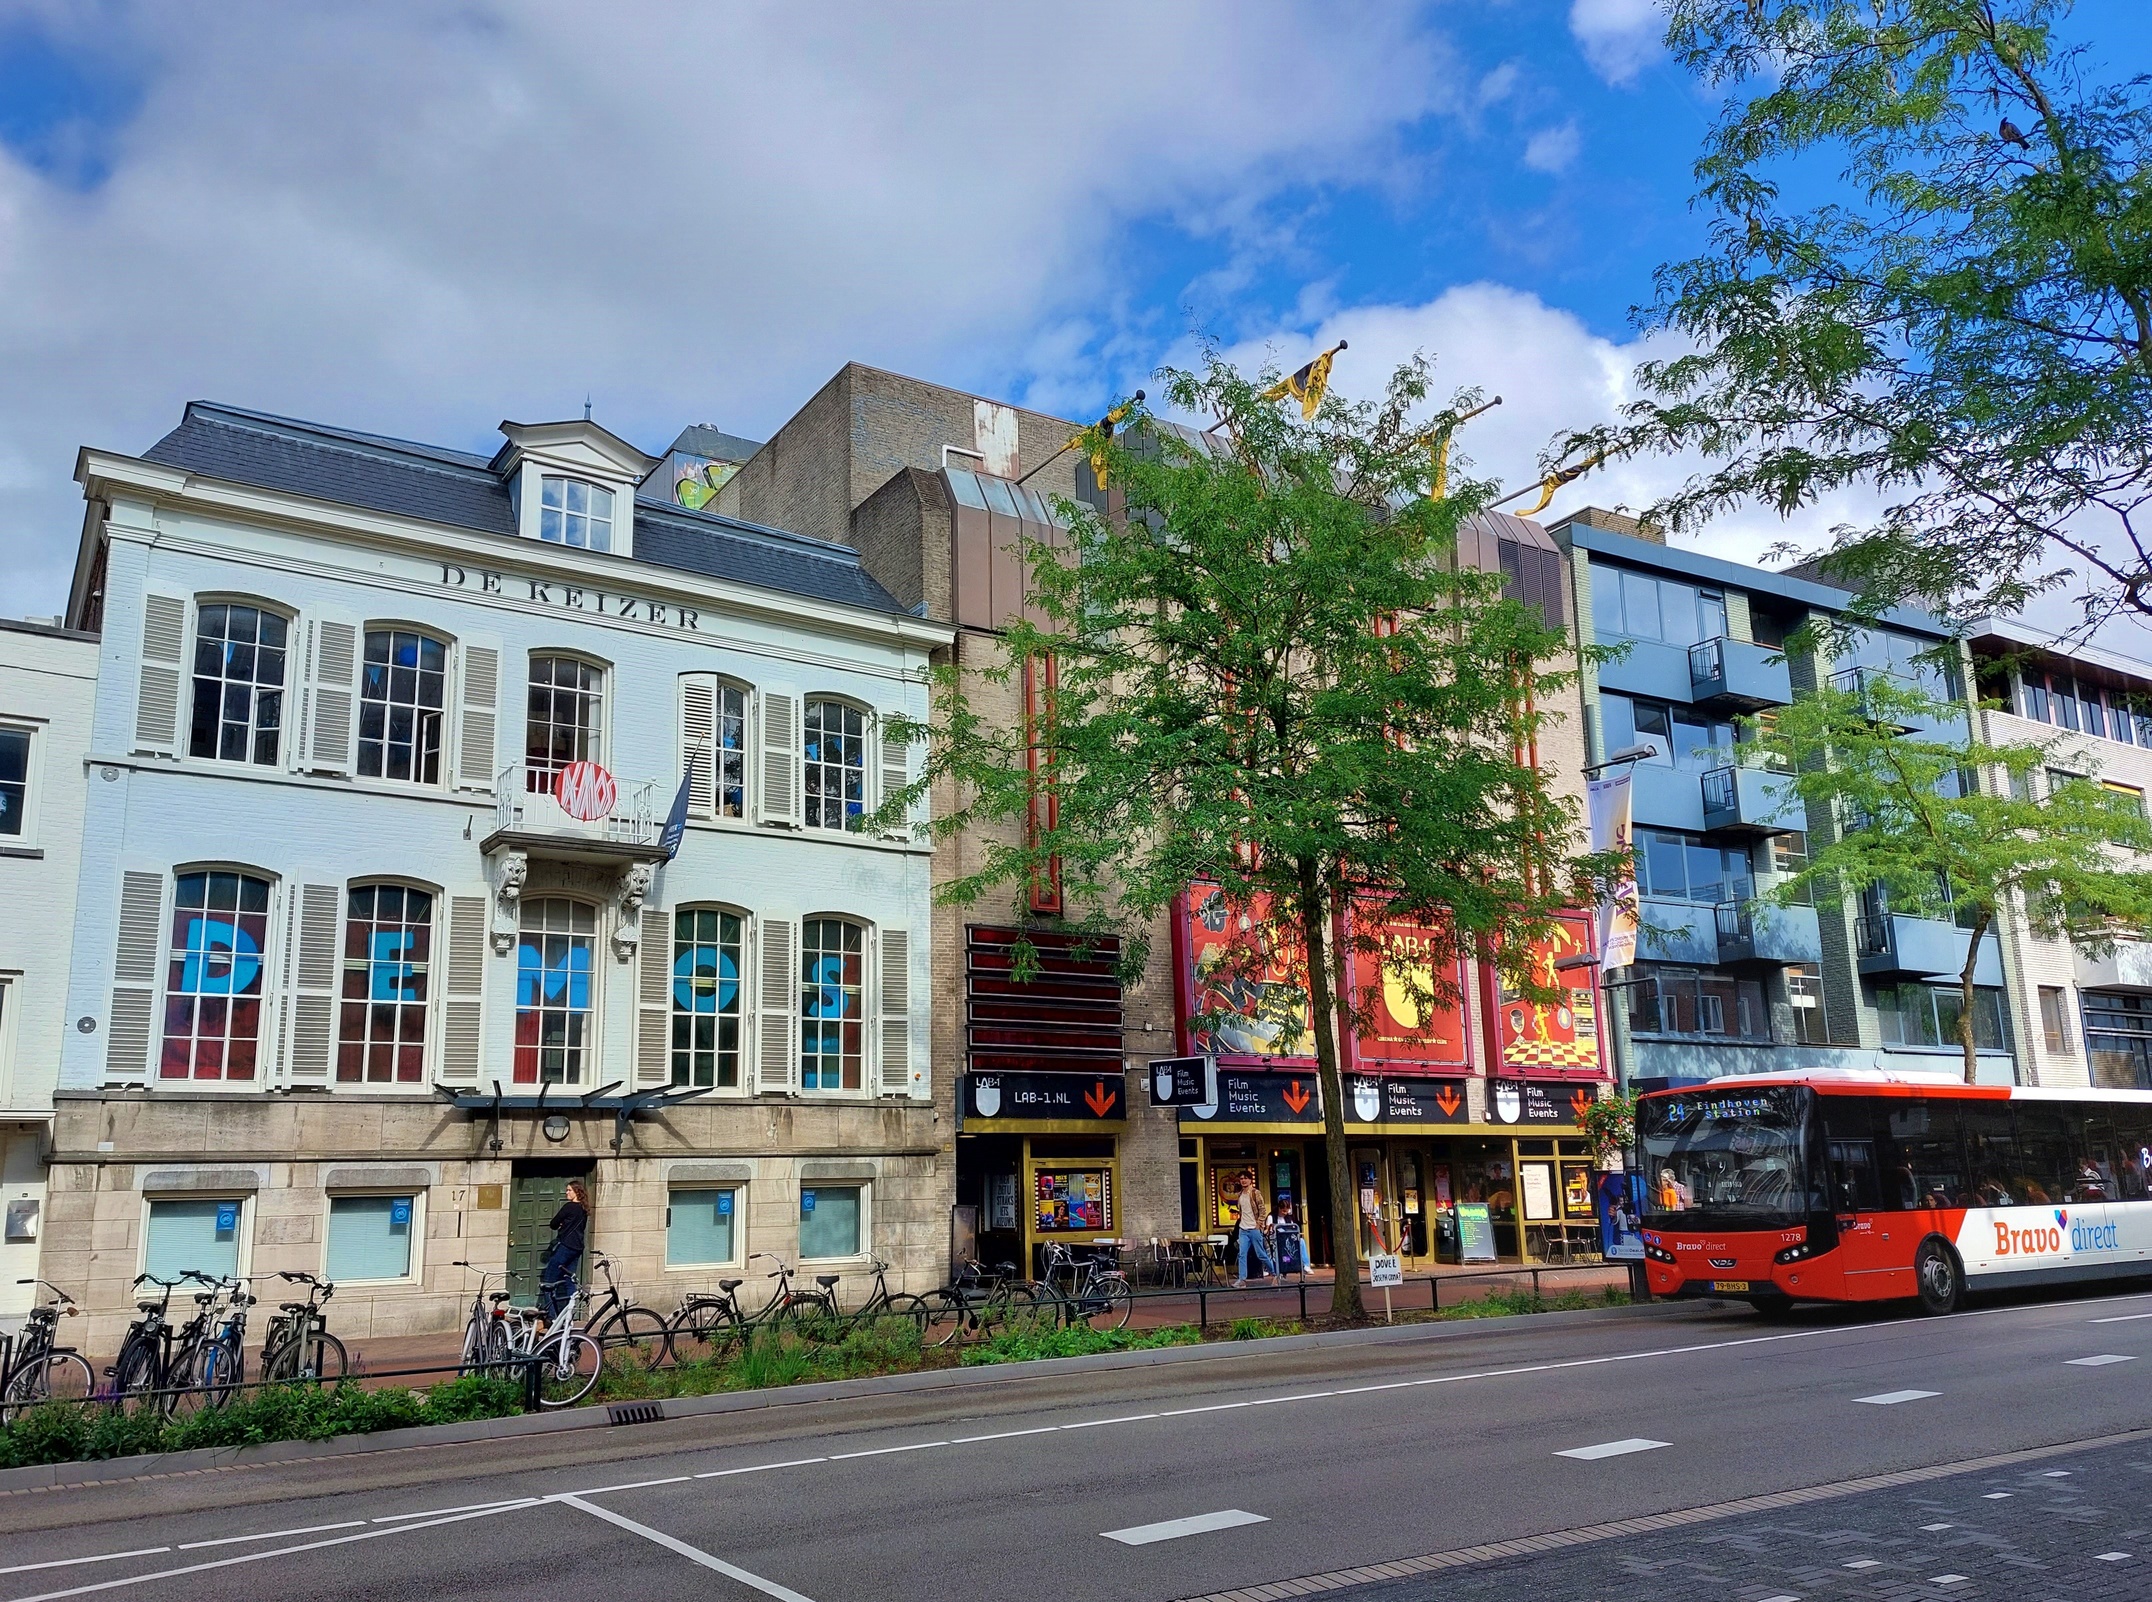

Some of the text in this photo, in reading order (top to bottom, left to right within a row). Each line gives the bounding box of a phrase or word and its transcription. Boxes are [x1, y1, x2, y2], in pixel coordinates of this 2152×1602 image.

[442, 564, 699, 630] DE KEIZER
[1177, 1069, 1189, 1077] Film
[976, 1077, 1000, 1088] LAB-1
[1177, 1077, 1194, 1086] Music
[1228, 1078, 1249, 1090] Film
[1353, 1076, 1379, 1089] LAB-1
[1177, 1087, 1198, 1095] Events
[1388, 1083, 1406, 1094] Film
[1526, 1087, 1543, 1097] Film
[1014, 1091, 1071, 1104] LAB-1.NL
[1229, 1090, 1258, 1101] Music
[1389, 1094, 1416, 1105] Music
[1229, 1102, 1266, 1113] Events
[1528, 1097, 1552, 1107] Music
[1697, 1098, 1768, 1111] Eindhoven
[1389, 1106, 1422, 1116] Events
[1529, 1109, 1559, 1118] Events
[1668, 1103, 1685, 1121] 24
[1705, 1108, 1760, 1119] Station
[452, 1190, 466, 1201] 17
[1781, 1233, 1802, 1241] 1278
[1994, 1218, 2119, 1255] Bravo direct
[1676, 1242, 1726, 1250] Bravo direct
[1375, 1259, 1391, 1268] DOVE
